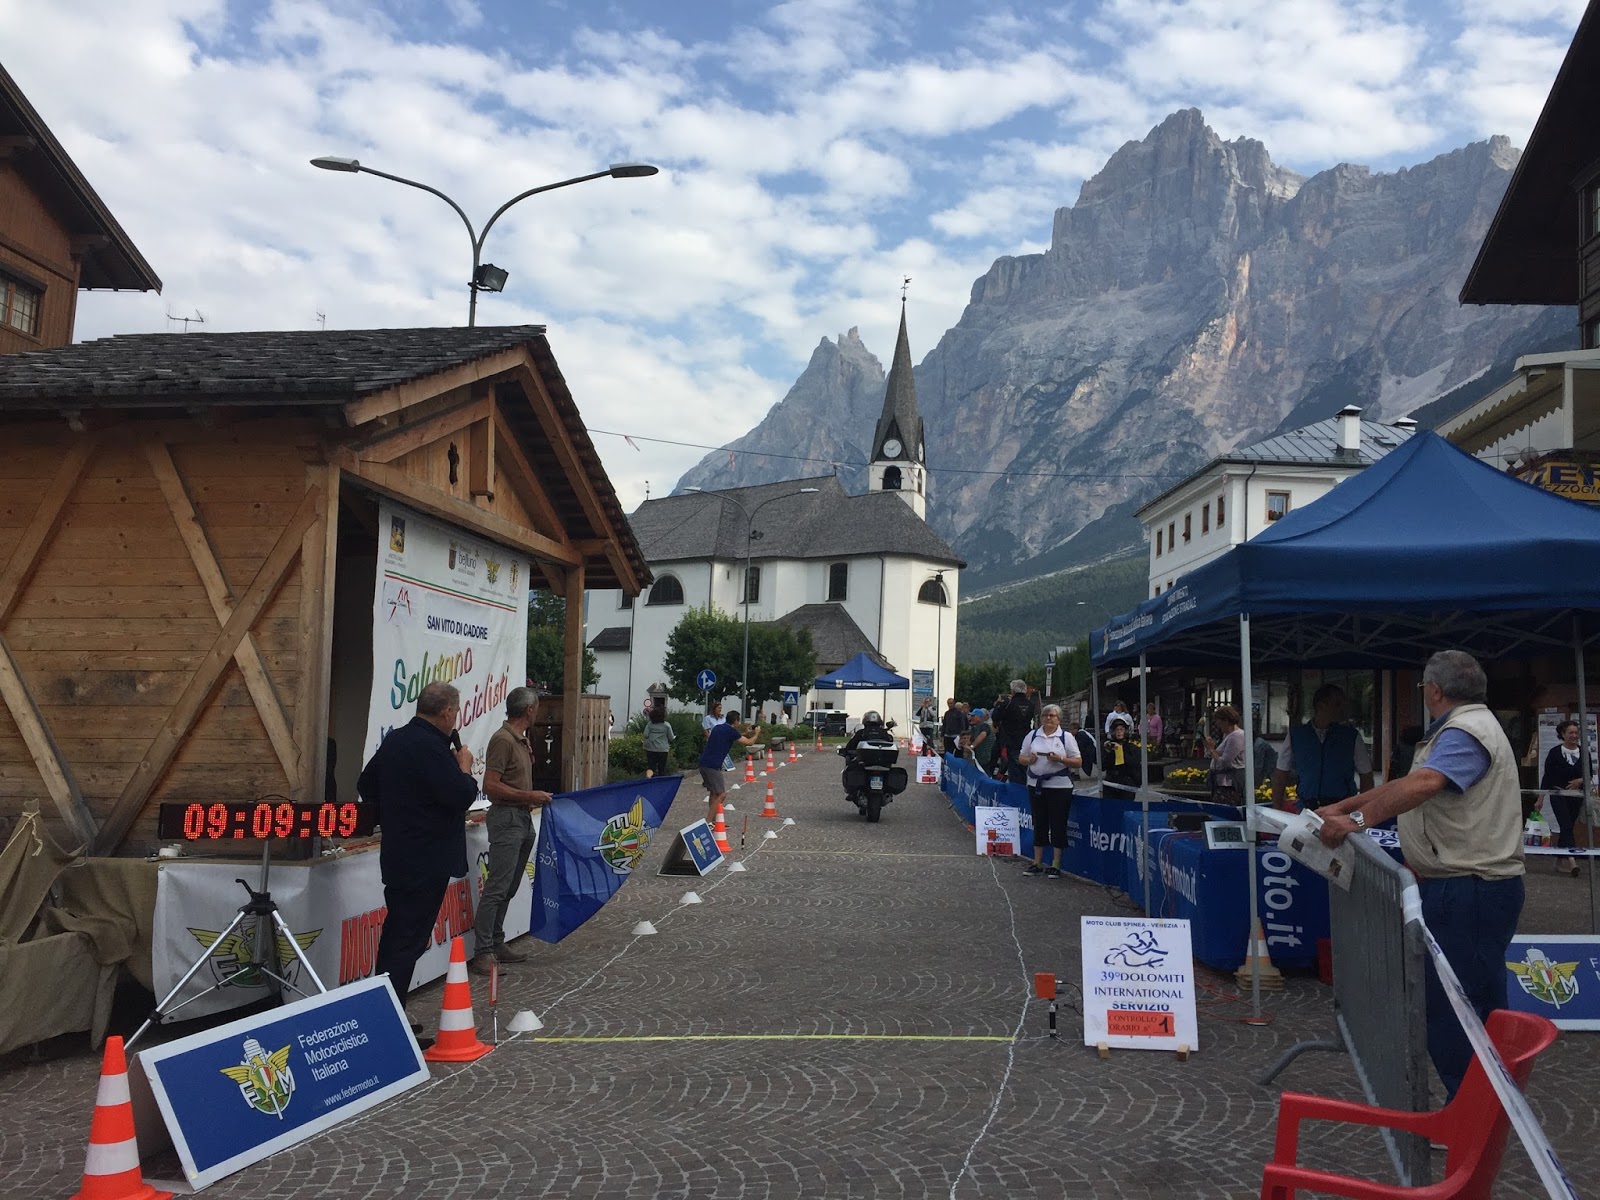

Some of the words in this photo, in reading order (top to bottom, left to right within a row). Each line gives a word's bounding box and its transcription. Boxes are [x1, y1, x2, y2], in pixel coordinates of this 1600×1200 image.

[427, 615, 440, 630] SAN
[441, 618, 455, 634] VITO
[456, 621, 462, 635] DI
[463, 622, 488, 640] CADORE
[183, 803, 358, 839] 09:09:09
[339, 904, 388, 985] MOT
[1094, 986, 1184, 999] INTERNATIONAL
[1112, 1001, 1170, 1011] SERVIZIO
[1108, 1015, 1157, 1023] CONTROLLO
[297, 1018, 359, 1049] Federazione
[304, 1031, 369, 1066] Motociclistica
[311, 1057, 350, 1082] Italiana
[323, 1075, 380, 1106] www.federmoto.it
